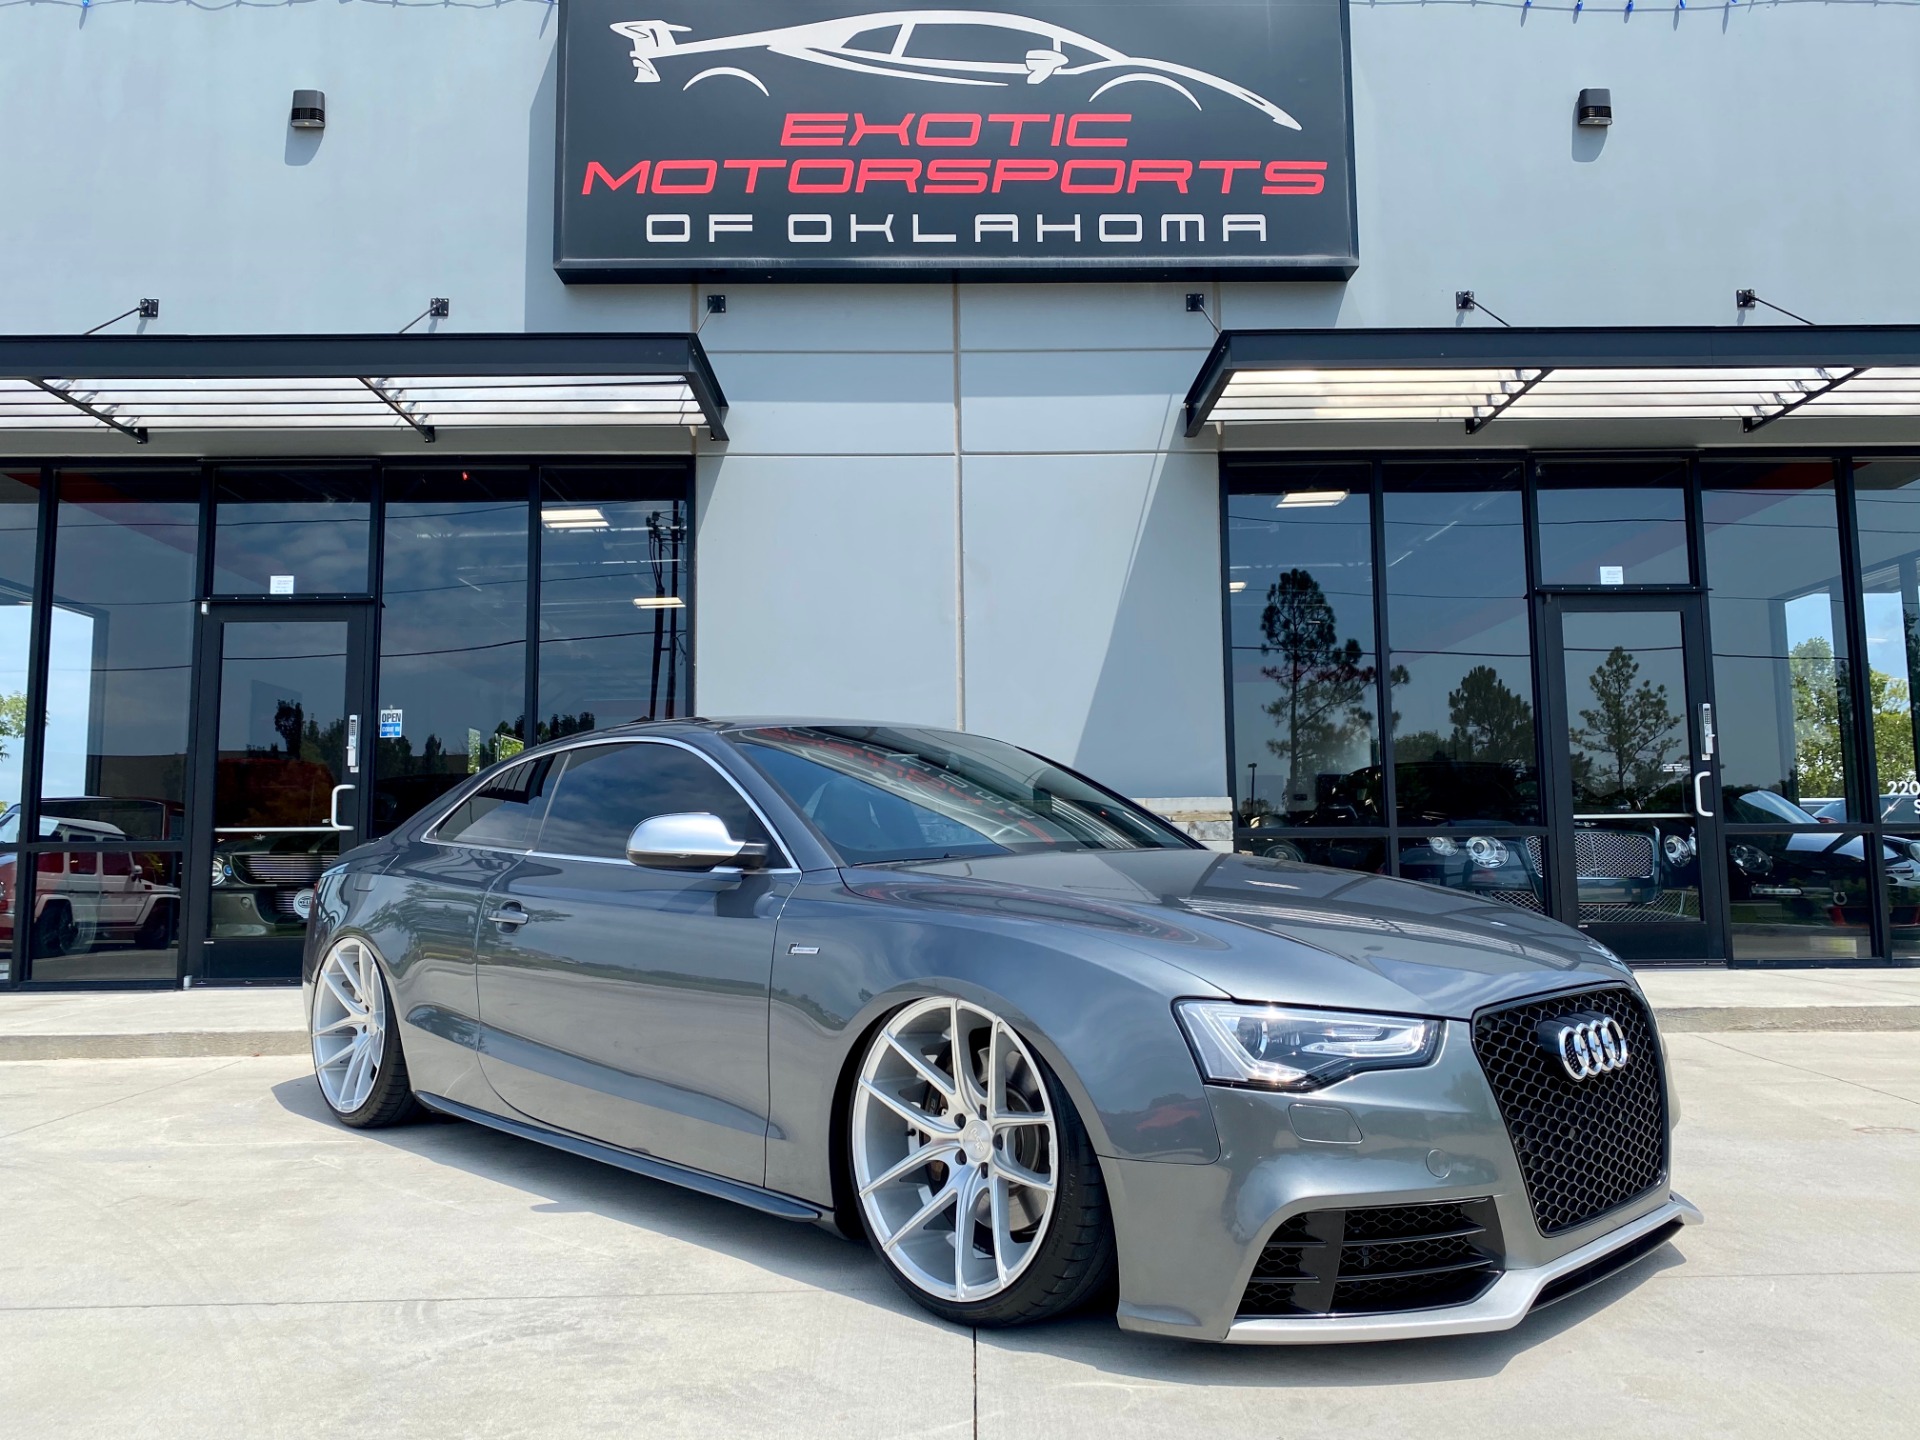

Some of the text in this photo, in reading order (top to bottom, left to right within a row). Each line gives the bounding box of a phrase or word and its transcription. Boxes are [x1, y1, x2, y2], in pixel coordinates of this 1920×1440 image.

[780, 113, 1132, 147] EXOTIC
[582, 158, 1328, 195] MOTORSPORTS
[646, 213, 1267, 243] OF OKLAHOMA
[381, 712, 402, 723] OPEN
